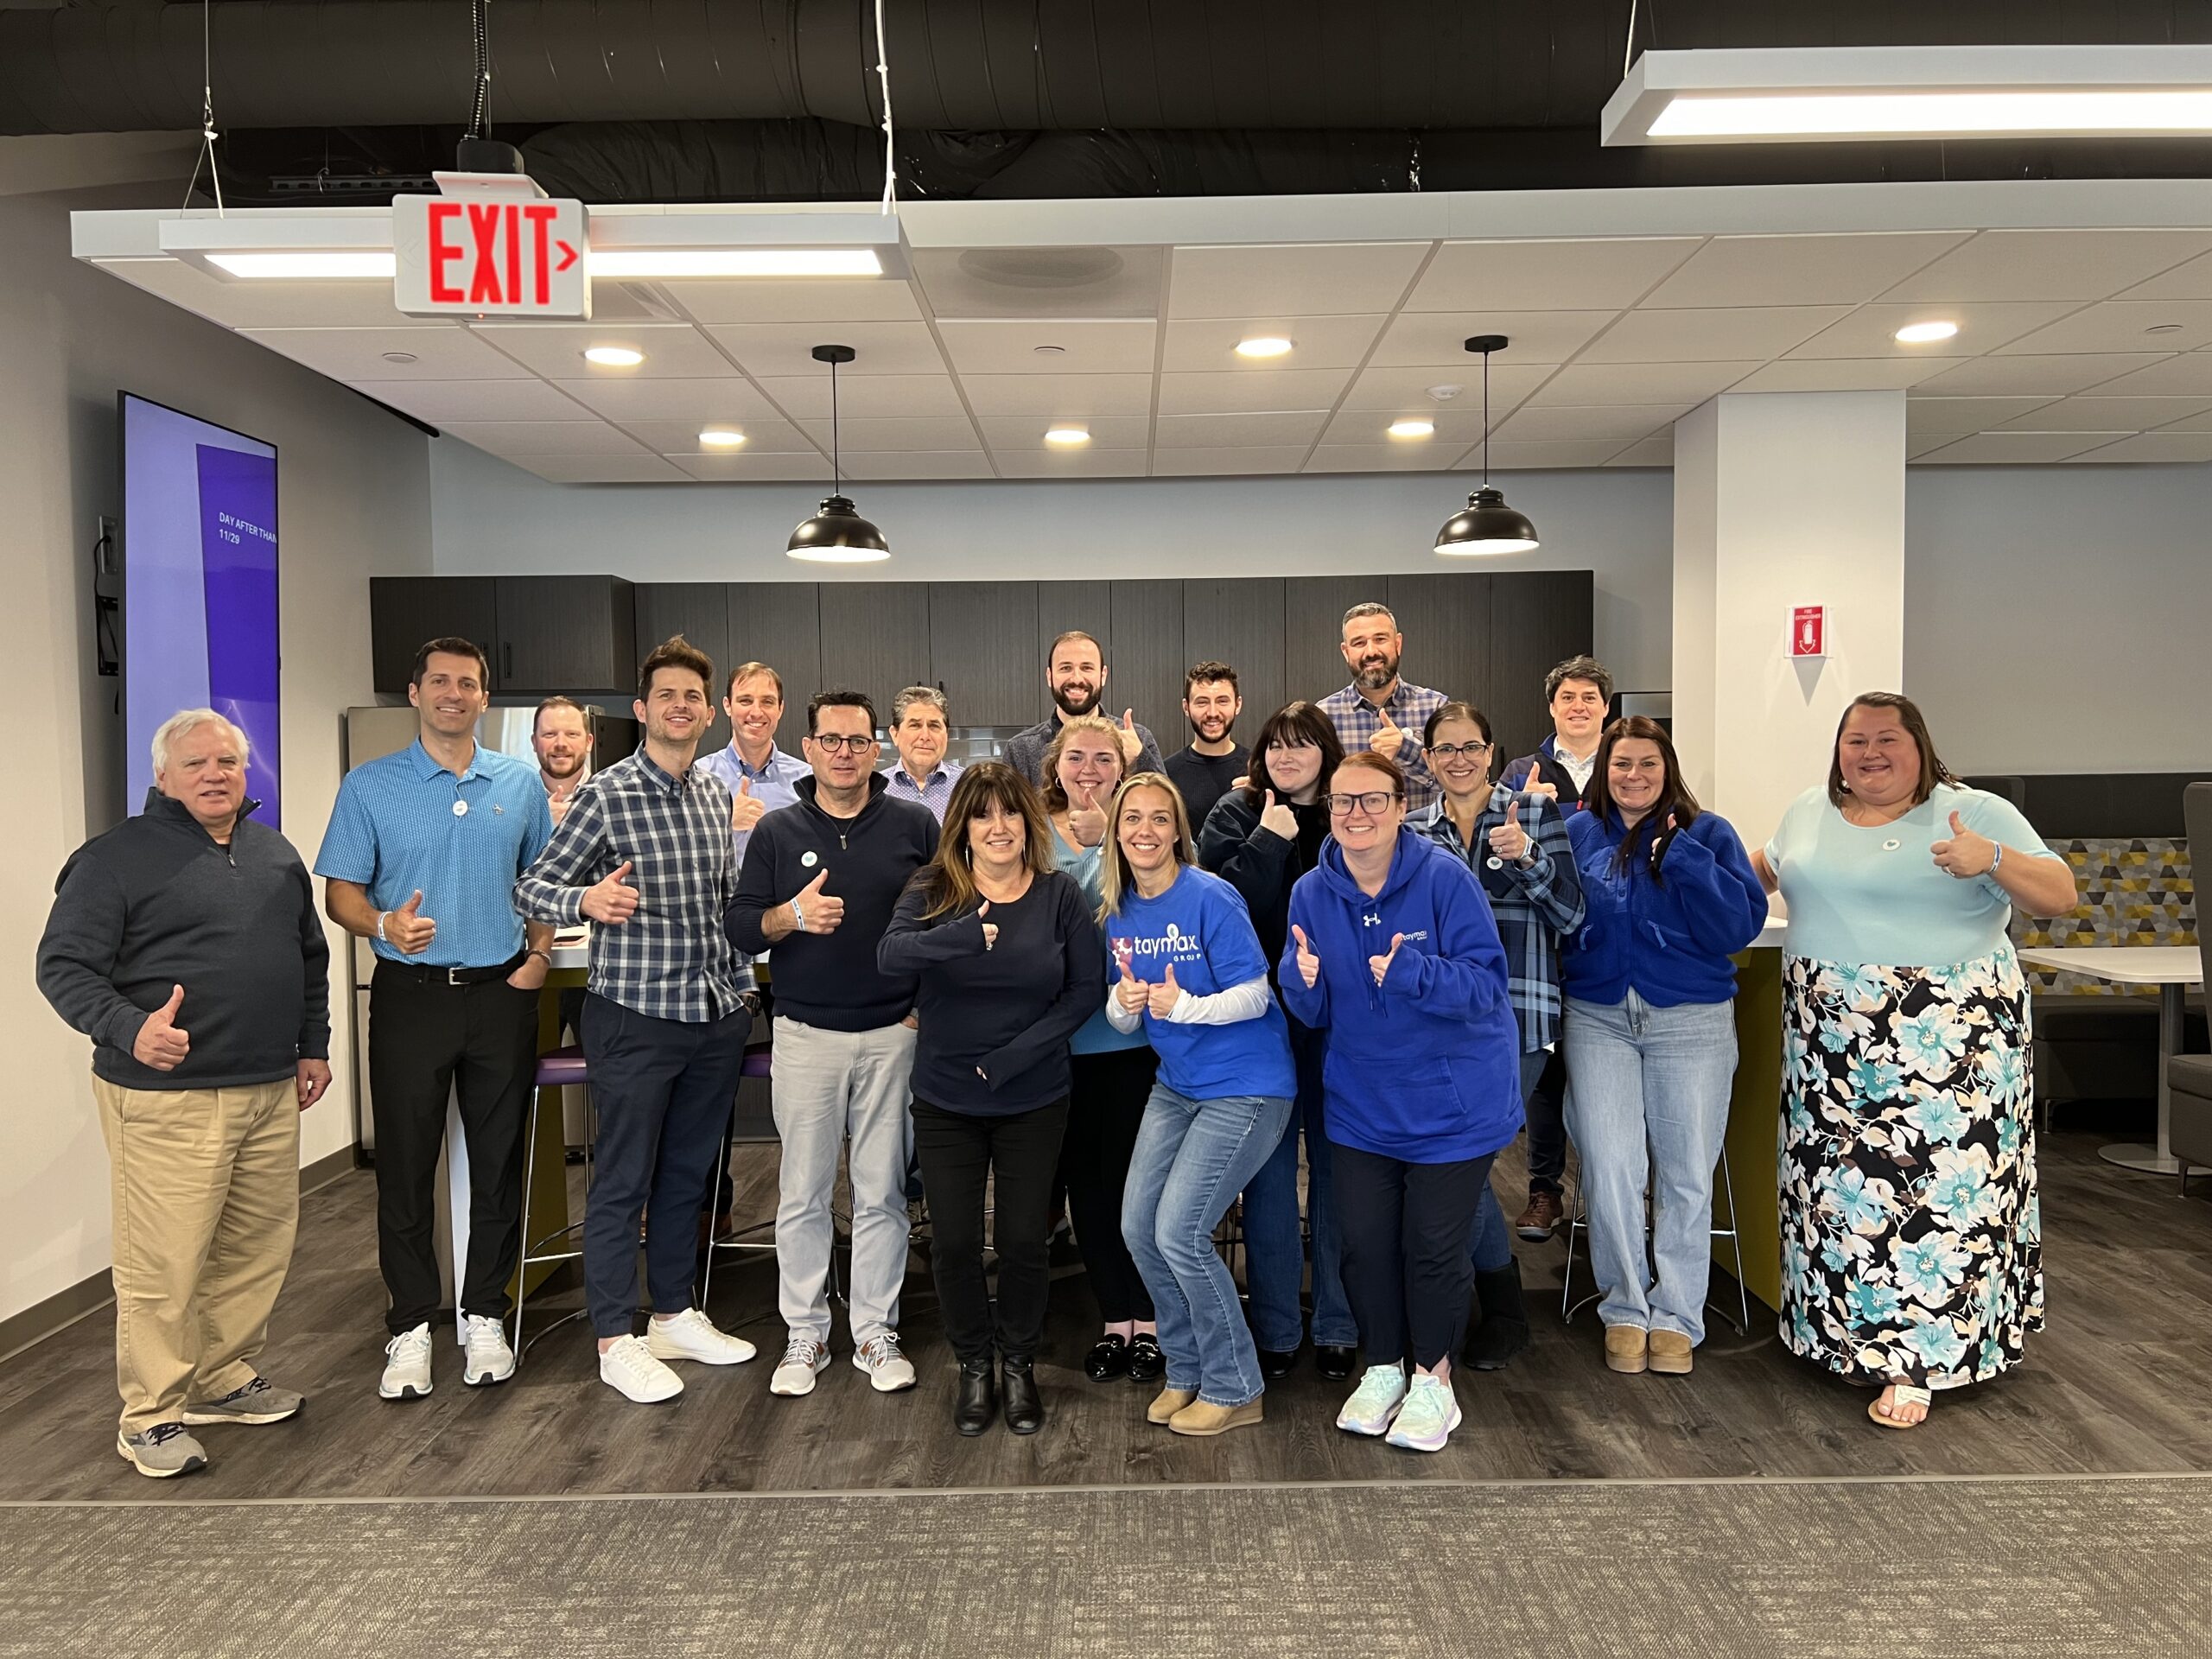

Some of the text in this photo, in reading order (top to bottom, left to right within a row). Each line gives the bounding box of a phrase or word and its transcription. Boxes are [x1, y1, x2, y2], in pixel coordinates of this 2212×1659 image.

[429, 203, 557, 305] EXIT
[219, 512, 235, 526] DAY
[235, 518, 258, 537] AFTER
[219, 528, 240, 544] 11/29
[1134, 934, 1199, 960] taymax
